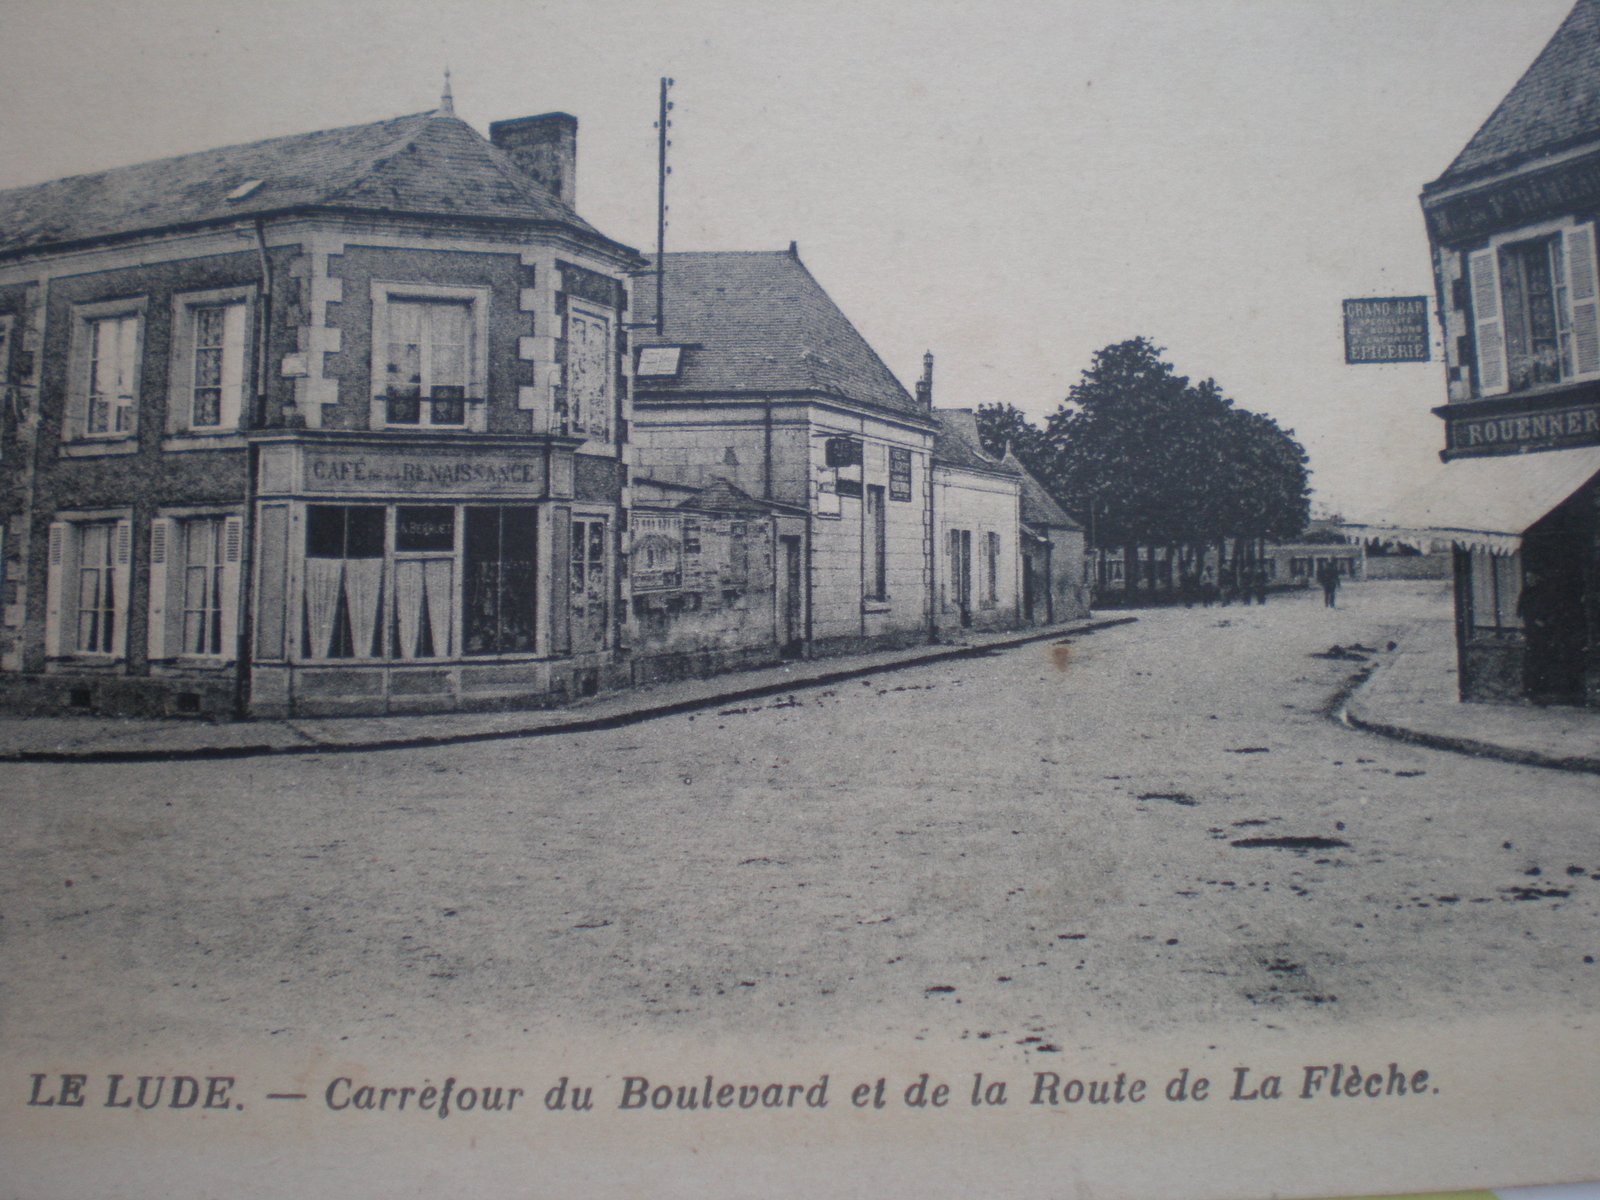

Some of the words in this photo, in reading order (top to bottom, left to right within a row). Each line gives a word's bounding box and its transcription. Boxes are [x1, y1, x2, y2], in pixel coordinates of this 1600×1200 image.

[1346, 301, 1390, 317] GRAND
[1397, 301, 1424, 315] BAR
[1350, 344, 1424, 360] EPICERIE
[403, 462, 534, 484] RENAISSANCE
[28, 1073, 88, 1107] LE
[104, 1074, 244, 1110] LUDE.
[545, 1076, 594, 1110] du
[618, 1074, 830, 1110] Boulevard
[852, 1077, 886, 1109] et
[904, 1072, 950, 1107] de
[971, 1072, 1008, 1106] la
[1030, 1072, 1147, 1105] Route
[1166, 1068, 1210, 1101] de
[1230, 1067, 1282, 1100] La
[1299, 1063, 1439, 1098] Flèche.
